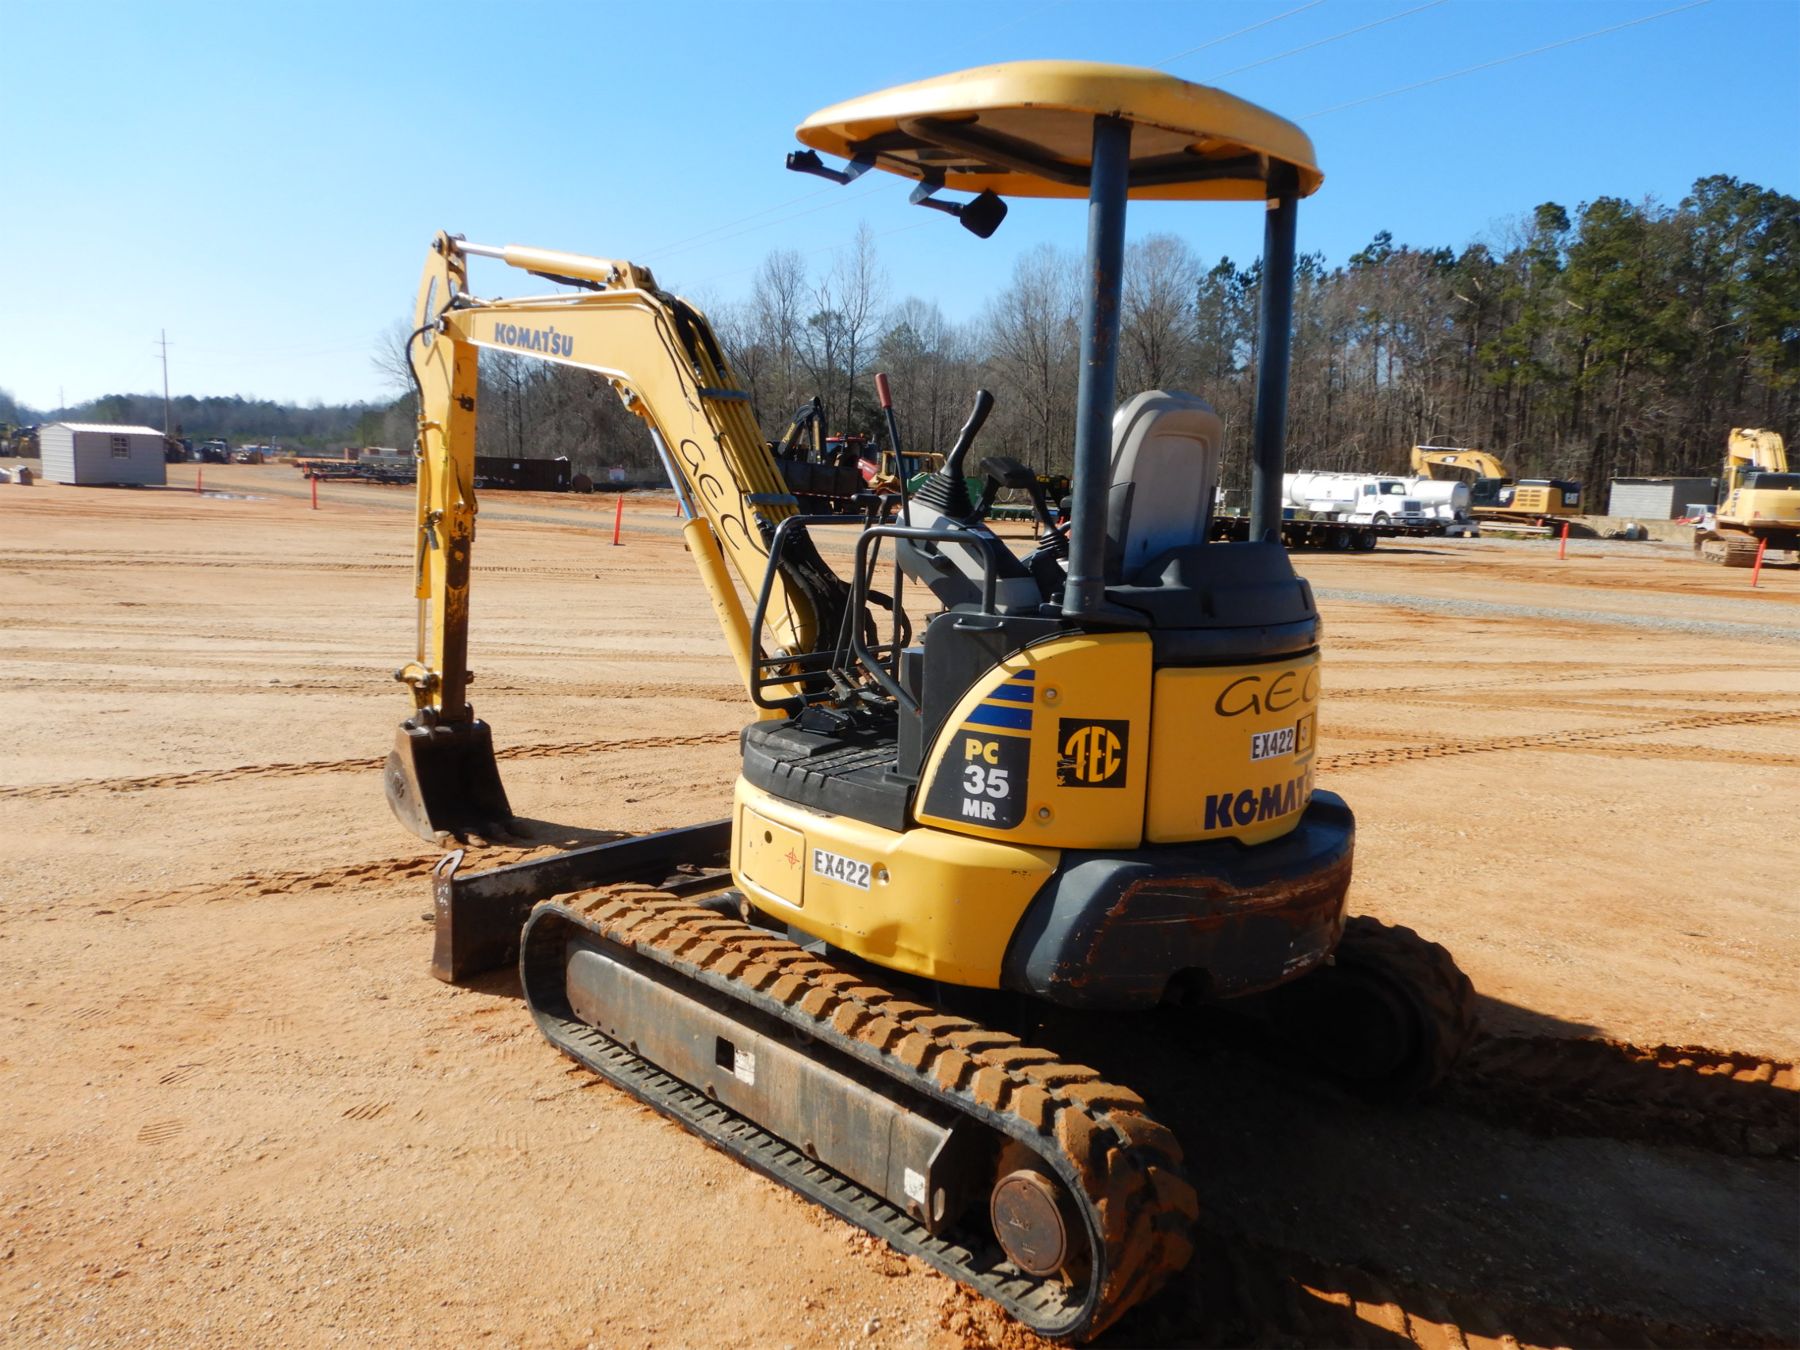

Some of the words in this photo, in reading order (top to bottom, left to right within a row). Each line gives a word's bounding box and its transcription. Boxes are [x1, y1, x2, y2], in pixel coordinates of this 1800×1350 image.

[494, 322, 574, 357] KOMATSU
[964, 738, 999, 765] PC
[1252, 728, 1294, 759] EX422
[963, 765, 1010, 799] 35
[962, 799, 997, 821] MR
[814, 850, 869, 888] EX422
